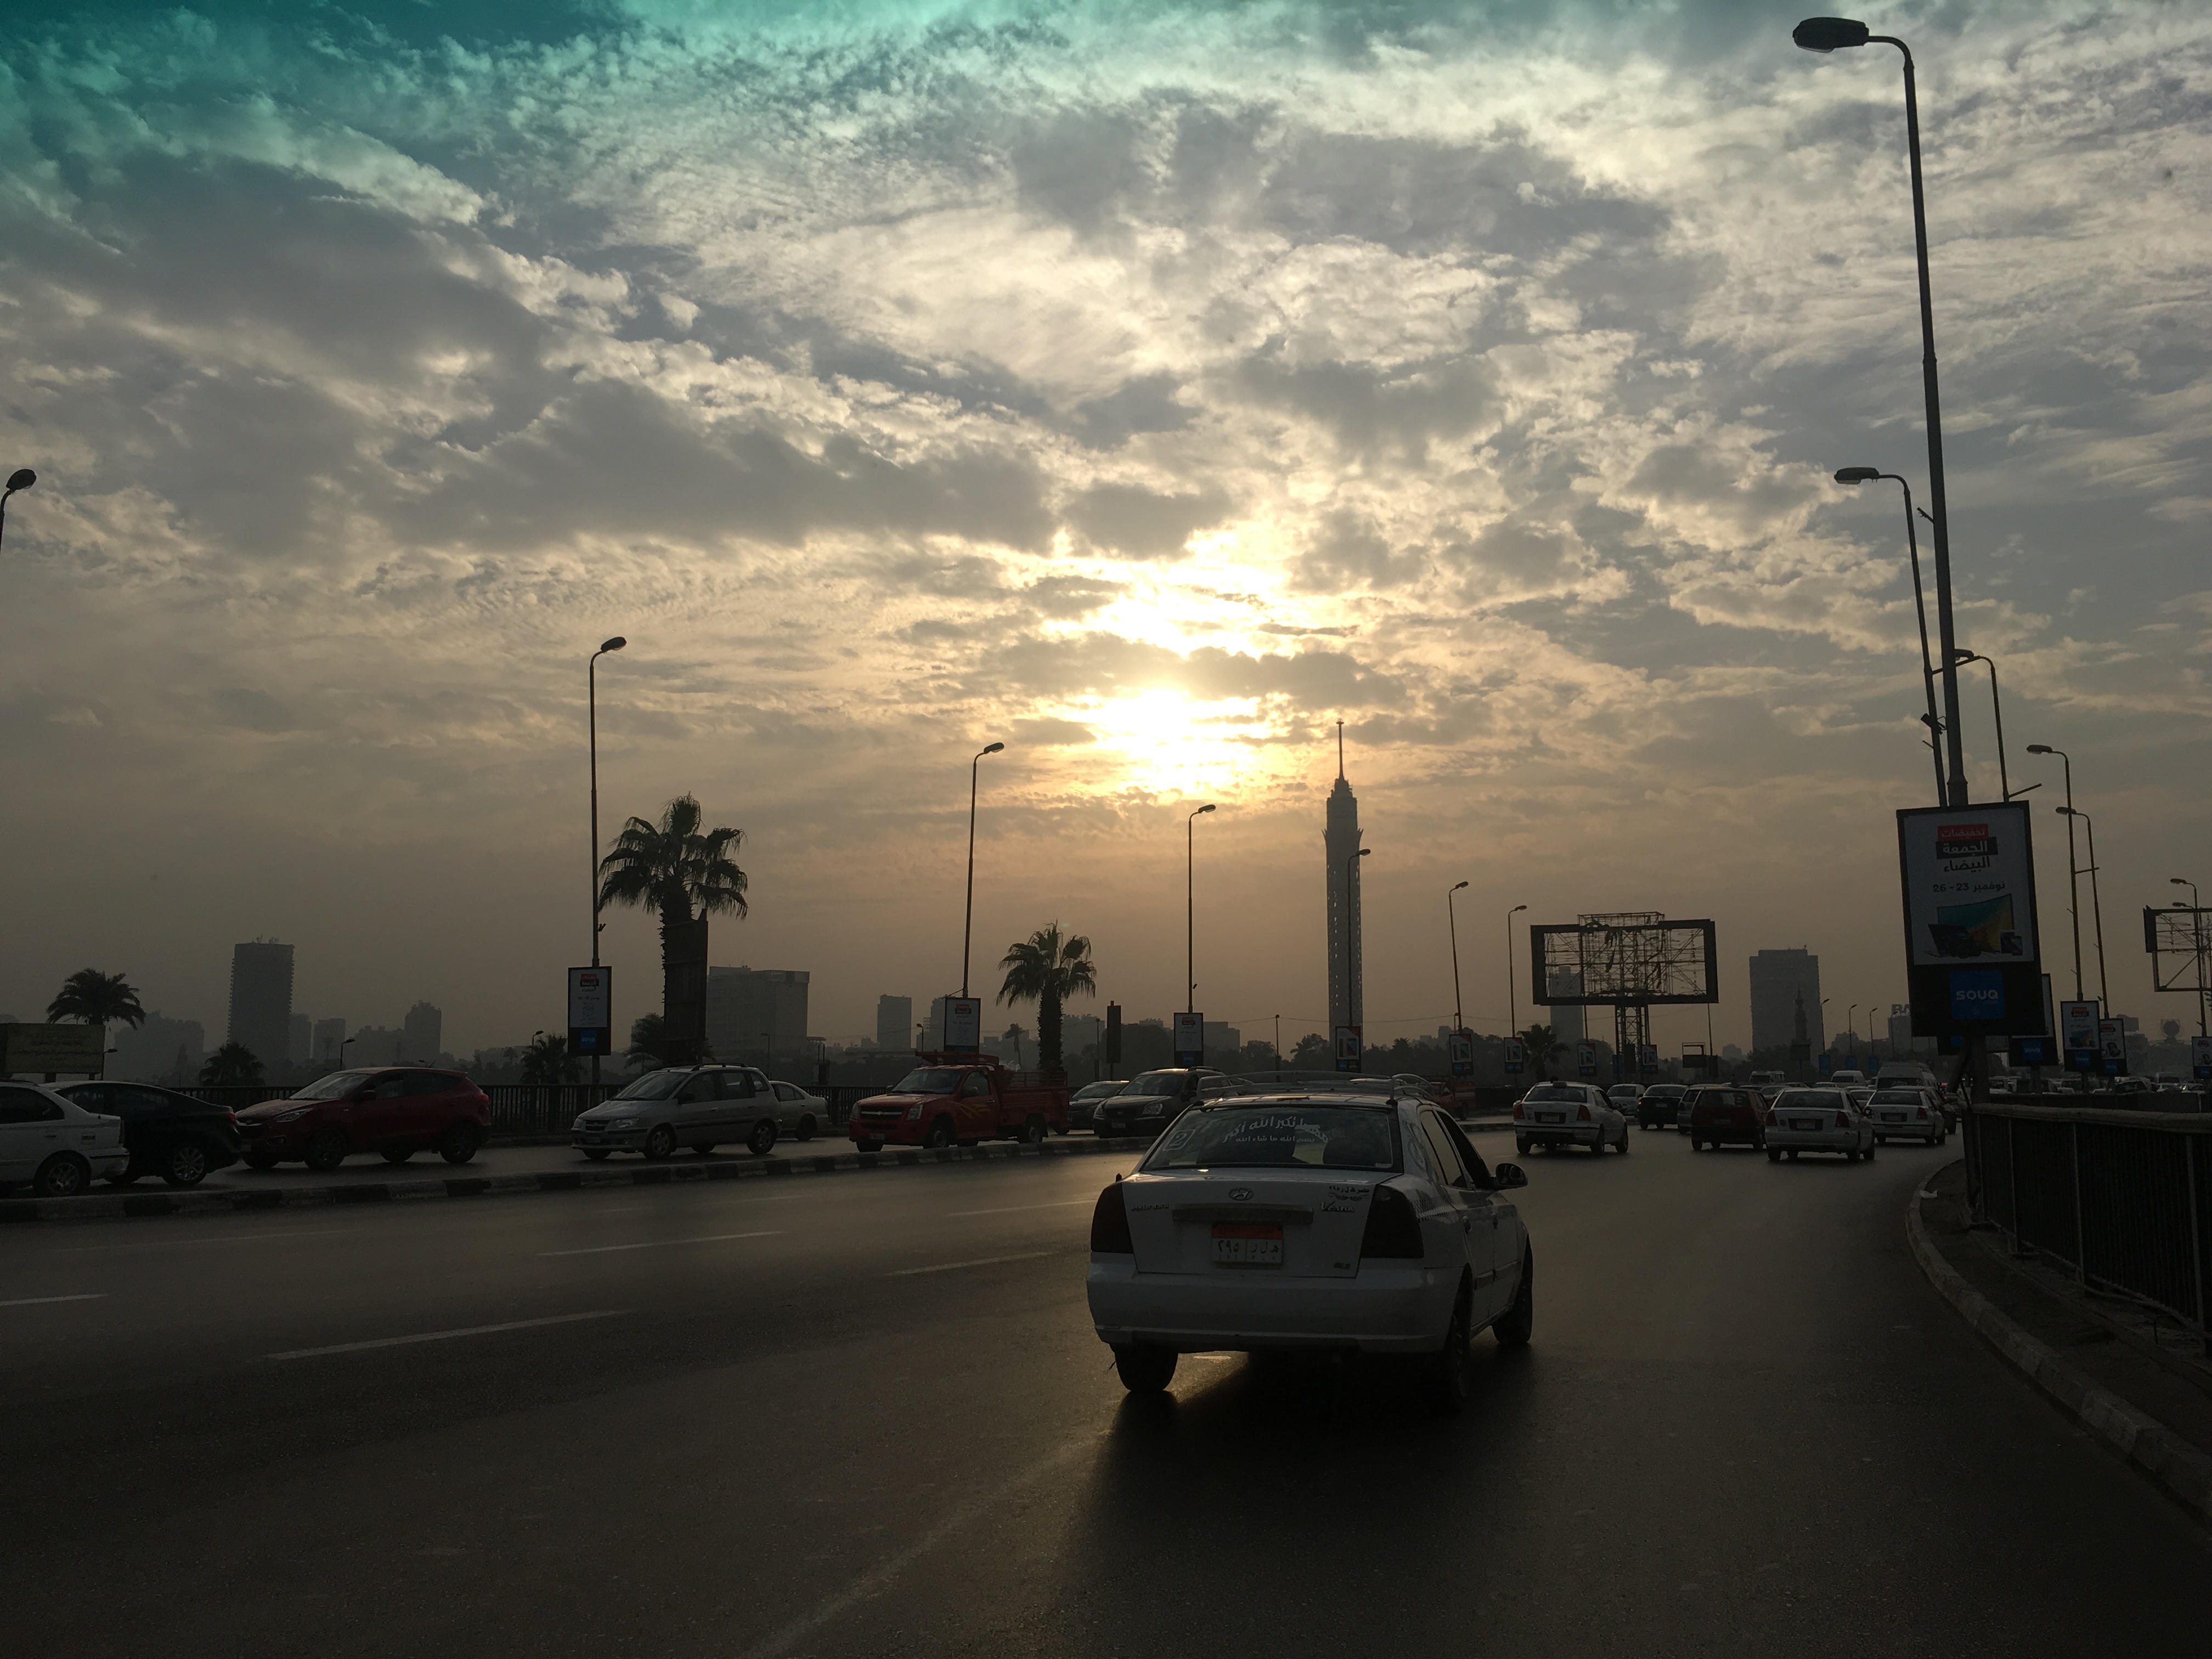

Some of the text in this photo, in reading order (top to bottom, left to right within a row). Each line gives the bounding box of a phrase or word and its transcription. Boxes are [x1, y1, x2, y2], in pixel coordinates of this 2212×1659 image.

[1941, 827, 1987, 839] تخفيضات
[1942, 840, 1988, 856] الجمعة
[1944, 856, 1990, 873] البيضاء
[1933, 884, 1946, 892] 26
[1956, 883, 1970, 891] 23
[1973, 881, 2006, 893] نوفمبر
[1249, 1116, 1274, 1130] الله
[1169, 1133, 1187, 1146] 2
